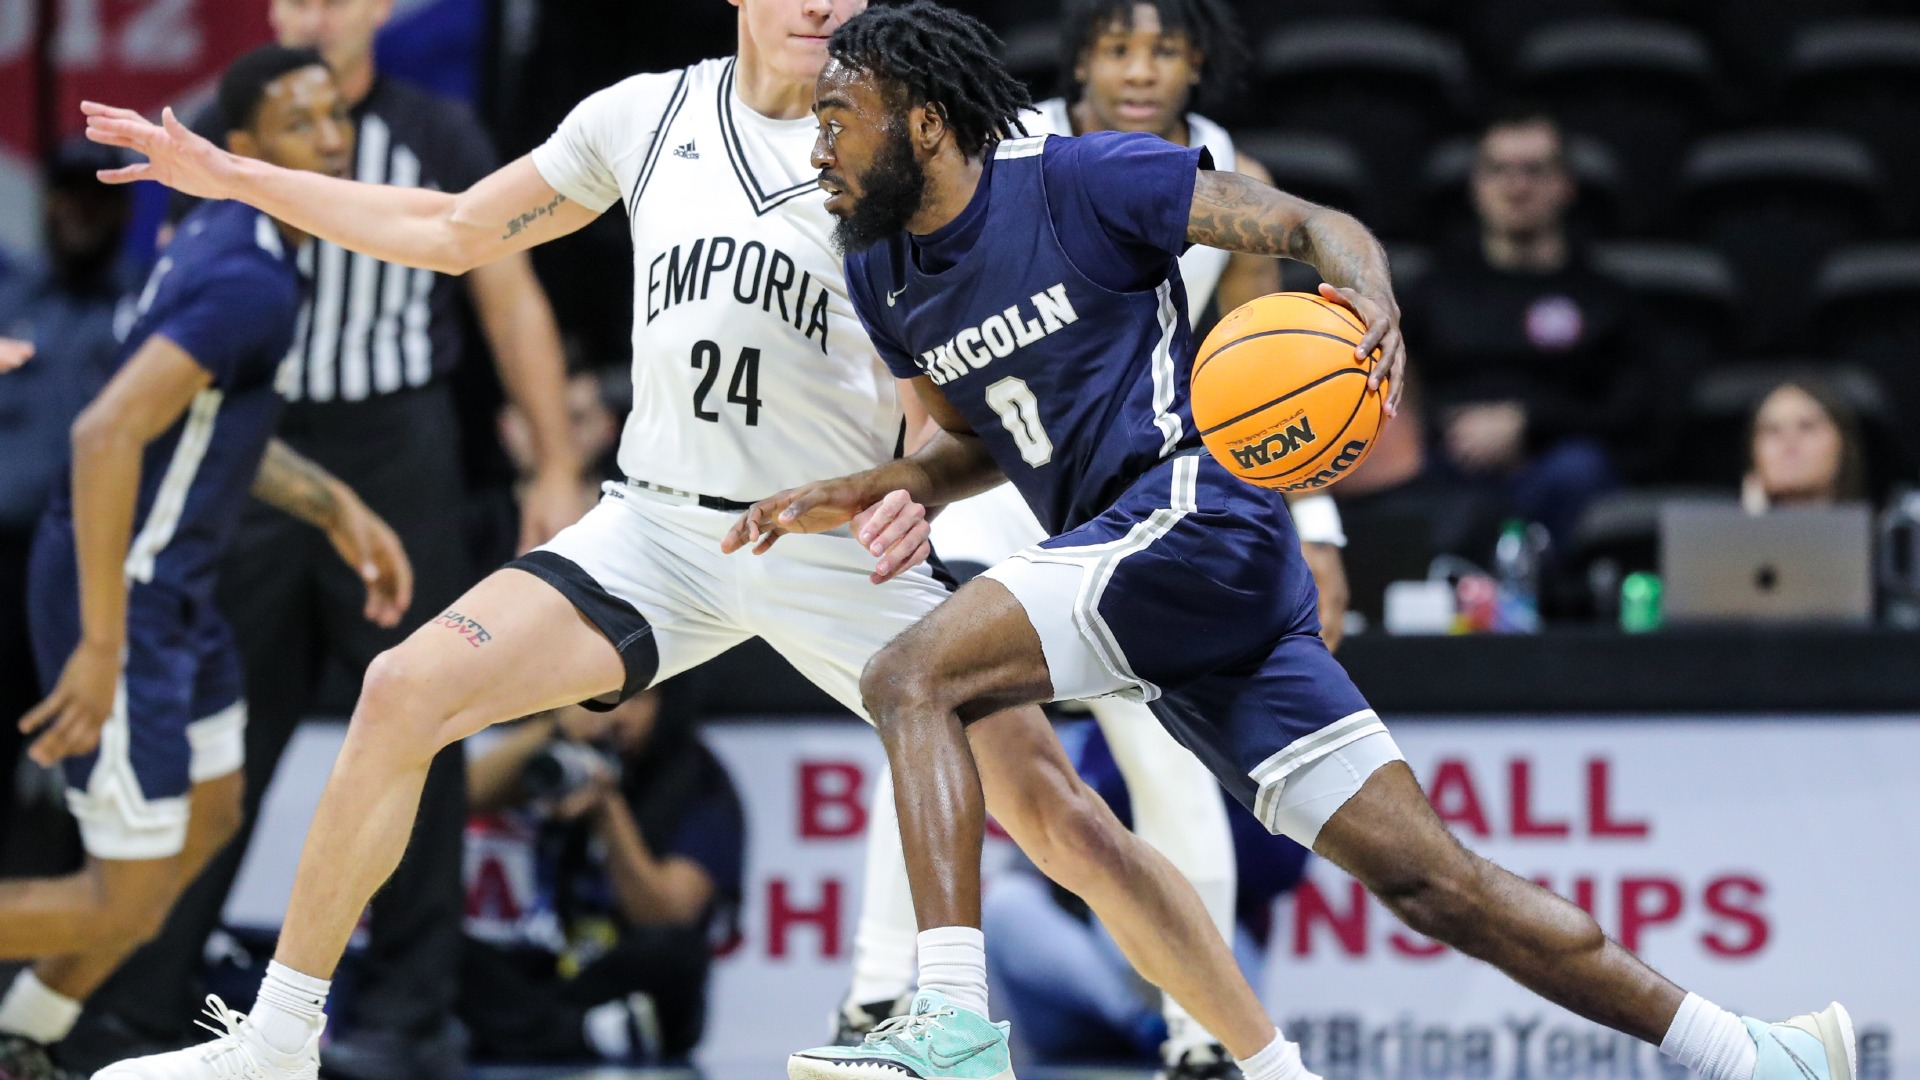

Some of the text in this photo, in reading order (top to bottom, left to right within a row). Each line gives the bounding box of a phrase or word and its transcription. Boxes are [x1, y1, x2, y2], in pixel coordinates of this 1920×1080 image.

[647, 236, 829, 356] EMPORIA
[691, 339, 762, 426] 24
[985, 375, 1054, 469] 0
[1228, 415, 1318, 470] NCAA
[1244, 429, 1268, 441] GAME
[1268, 408, 1305, 432] OFFICIAL
